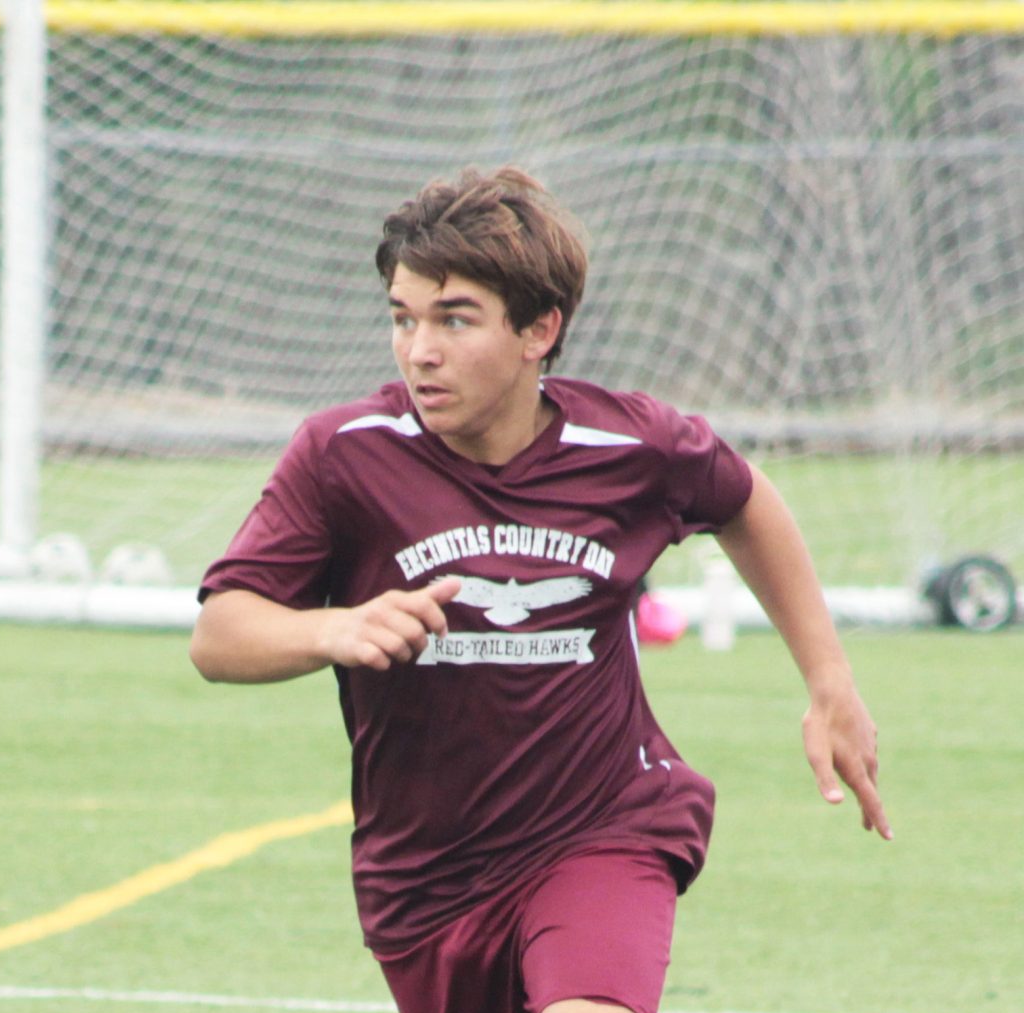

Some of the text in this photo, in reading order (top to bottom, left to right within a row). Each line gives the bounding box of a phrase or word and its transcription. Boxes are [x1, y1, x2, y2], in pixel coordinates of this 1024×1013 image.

[494, 523, 587, 565] COUNTRY
[435, 636, 580, 659] RED-TAILED HAWKS
